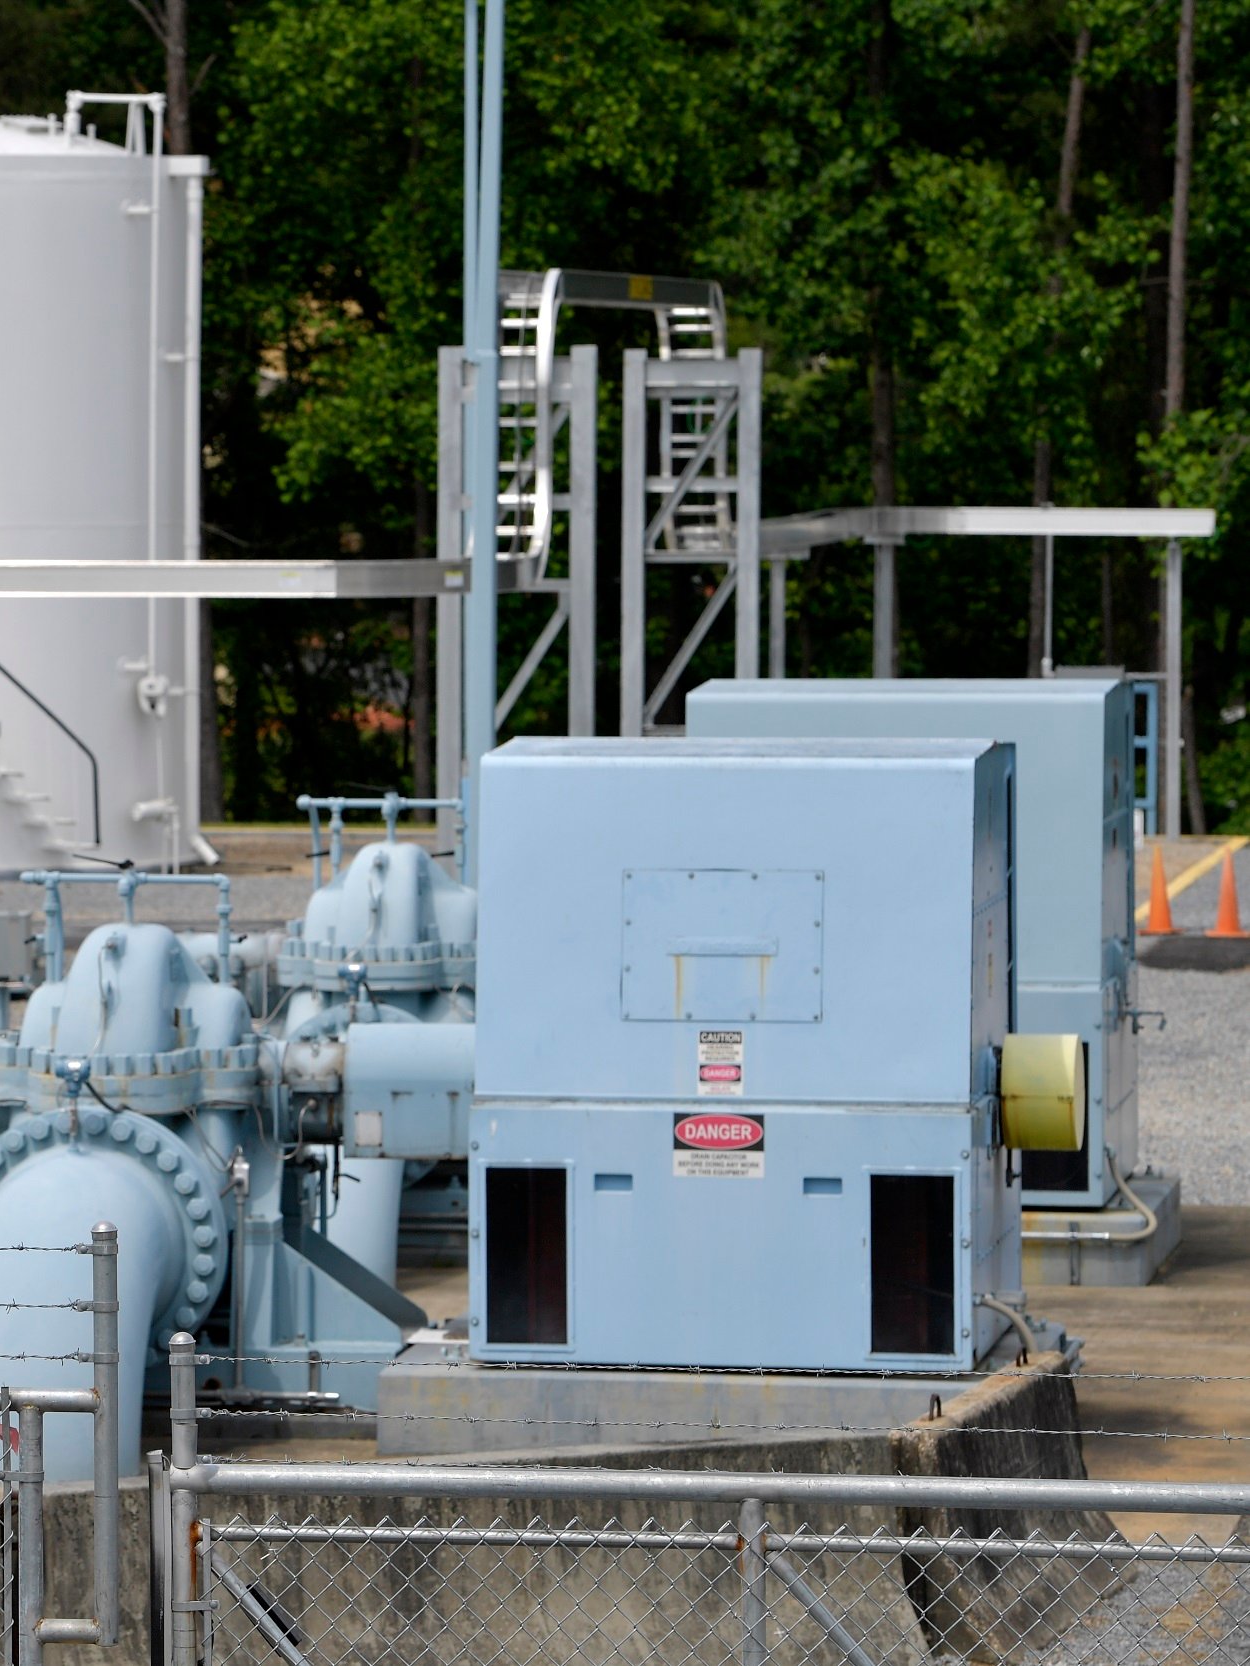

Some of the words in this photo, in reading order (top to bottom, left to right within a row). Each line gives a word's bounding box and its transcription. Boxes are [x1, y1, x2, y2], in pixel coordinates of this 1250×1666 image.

[701, 1032, 741, 1043] CAUTION
[704, 1068, 736, 1077] DANGER
[684, 1123, 752, 1141] DANGER
